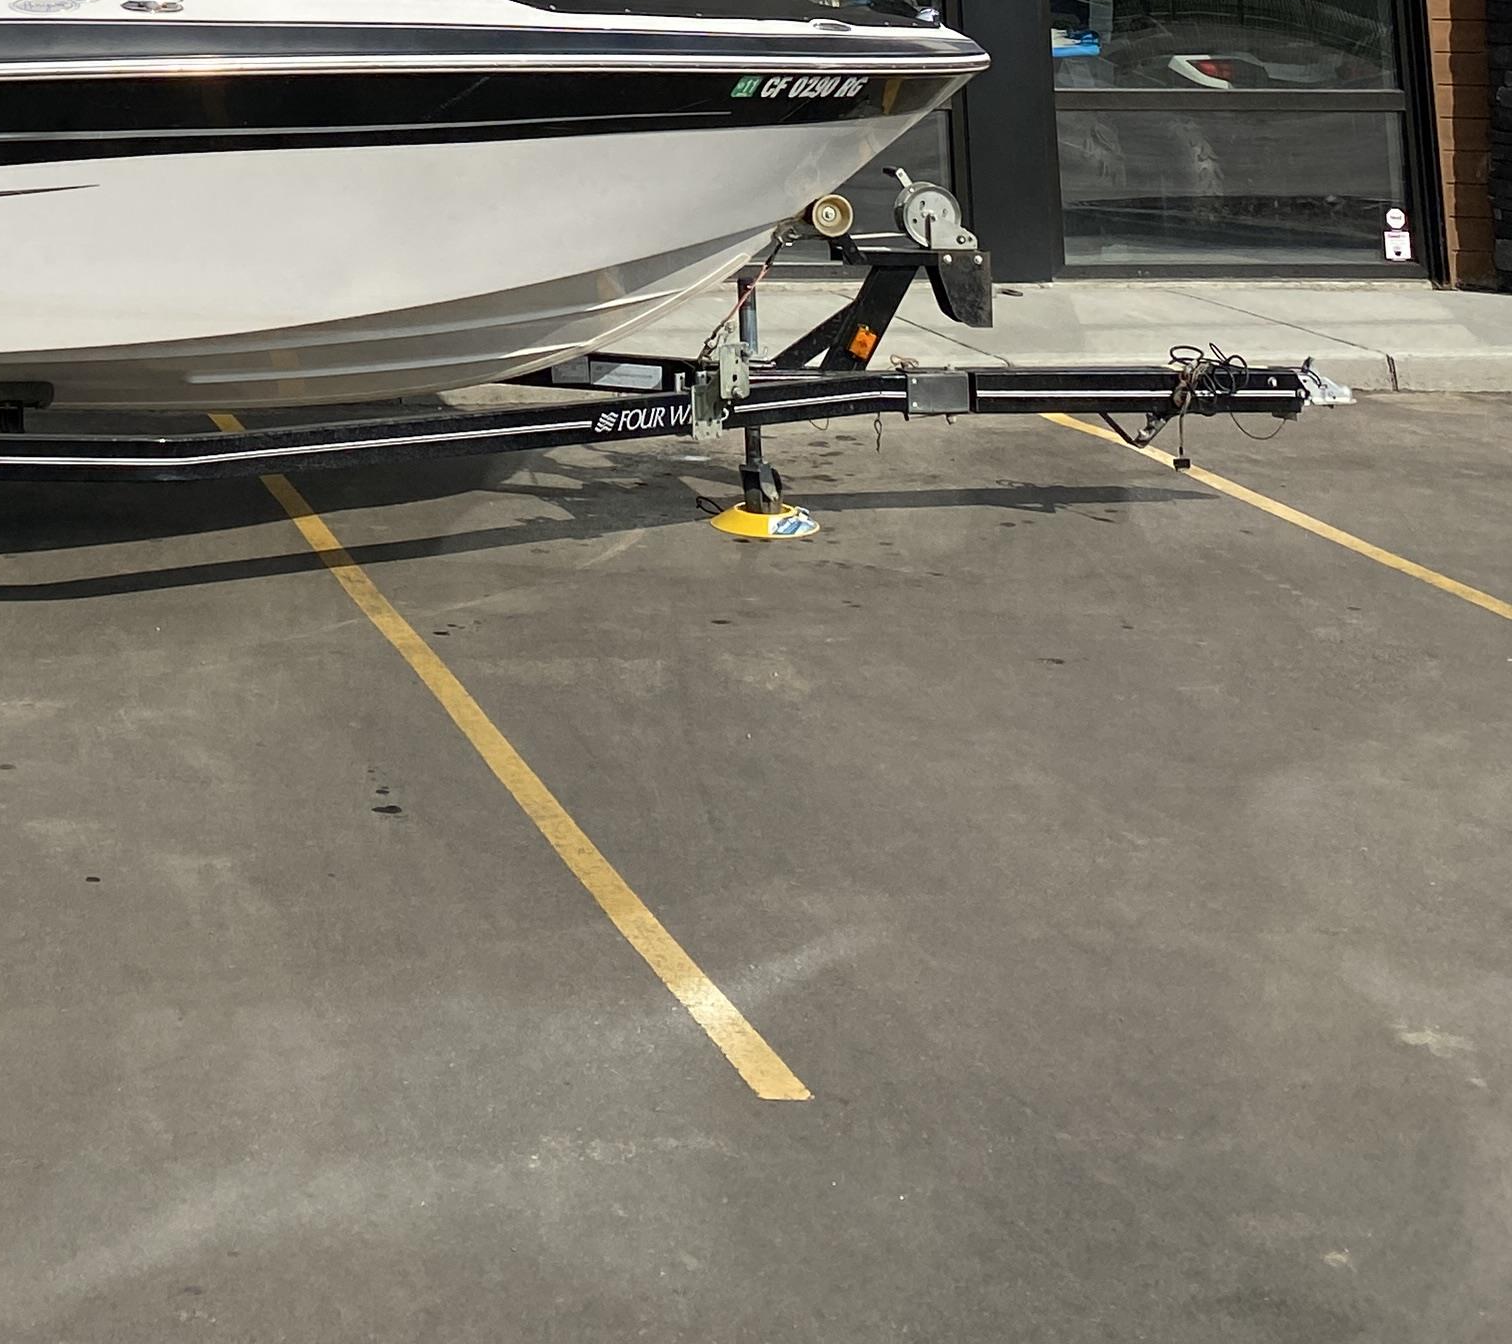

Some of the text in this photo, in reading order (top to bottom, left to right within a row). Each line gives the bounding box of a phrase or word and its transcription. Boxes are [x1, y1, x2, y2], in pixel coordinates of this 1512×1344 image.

[760, 76, 793, 98] CF
[788, 76, 841, 99] 0290
[618, 407, 666, 432] FOUR
